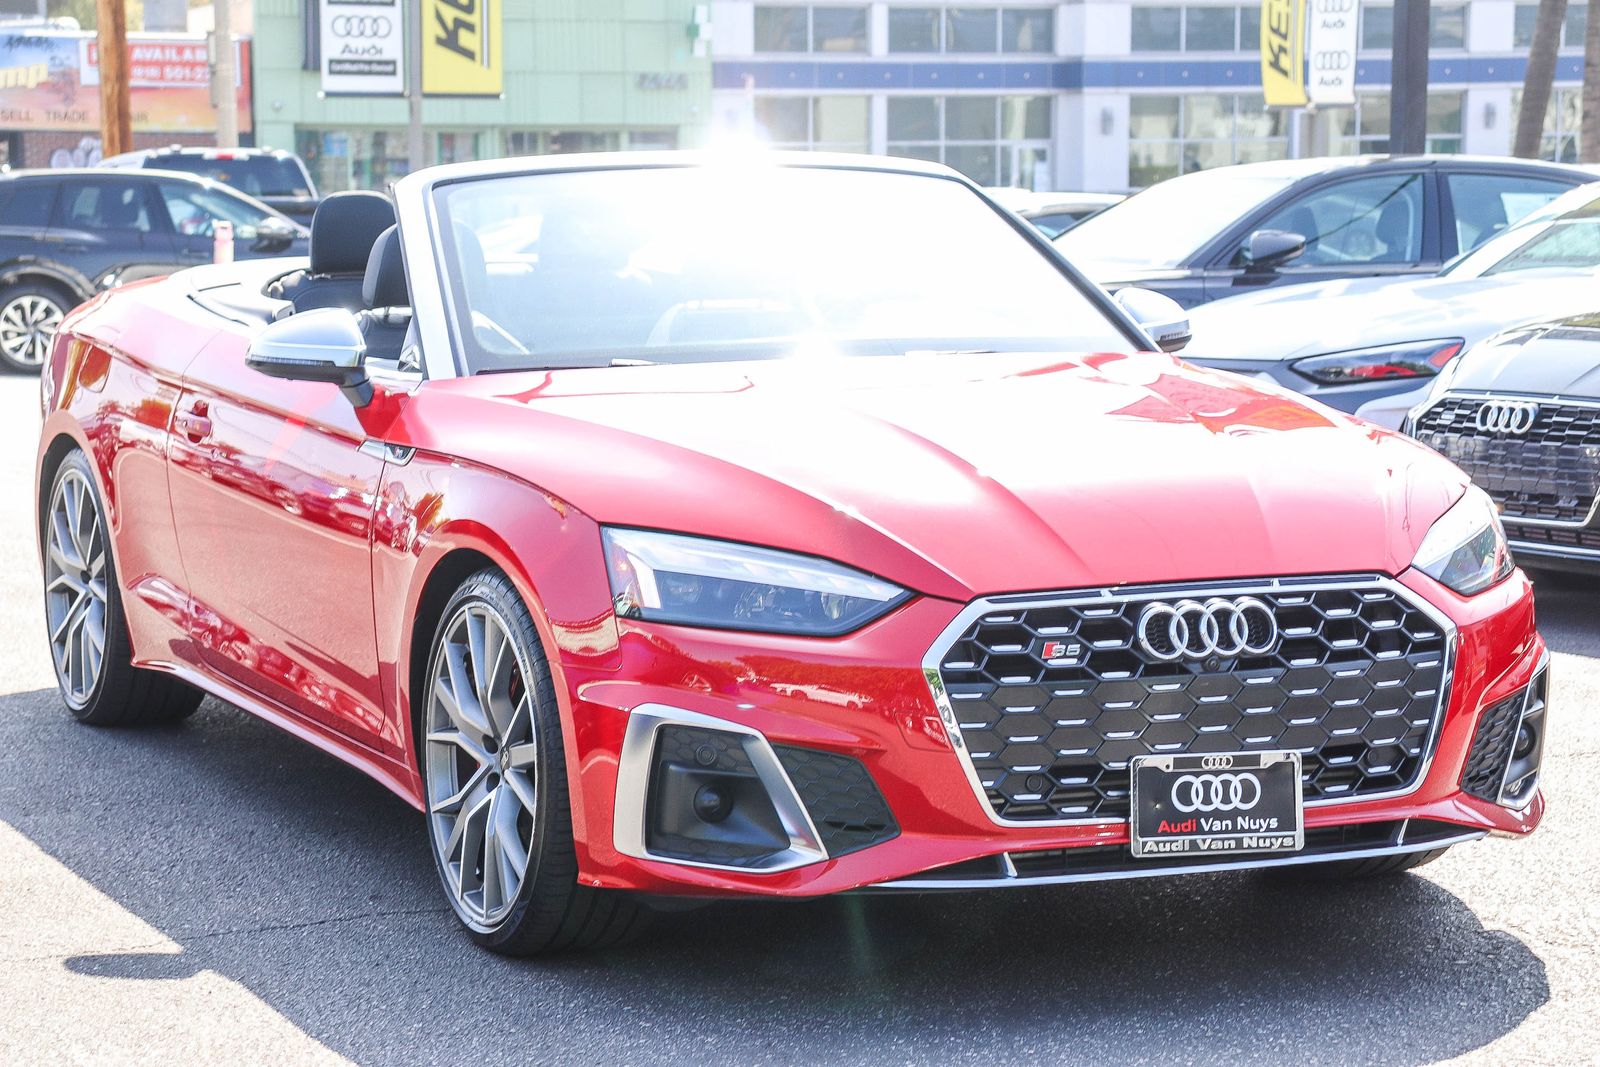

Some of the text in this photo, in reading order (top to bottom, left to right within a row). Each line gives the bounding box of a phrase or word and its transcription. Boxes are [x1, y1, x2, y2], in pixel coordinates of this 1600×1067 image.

[1268, 0, 1289, 78] KE
[340, 43, 383, 56] Audi
[1, 110, 88, 122] SELL TRADE
[1157, 816, 1279, 833] Audi Van Nuys
[1143, 835, 1295, 853] Audi Van Nuys
